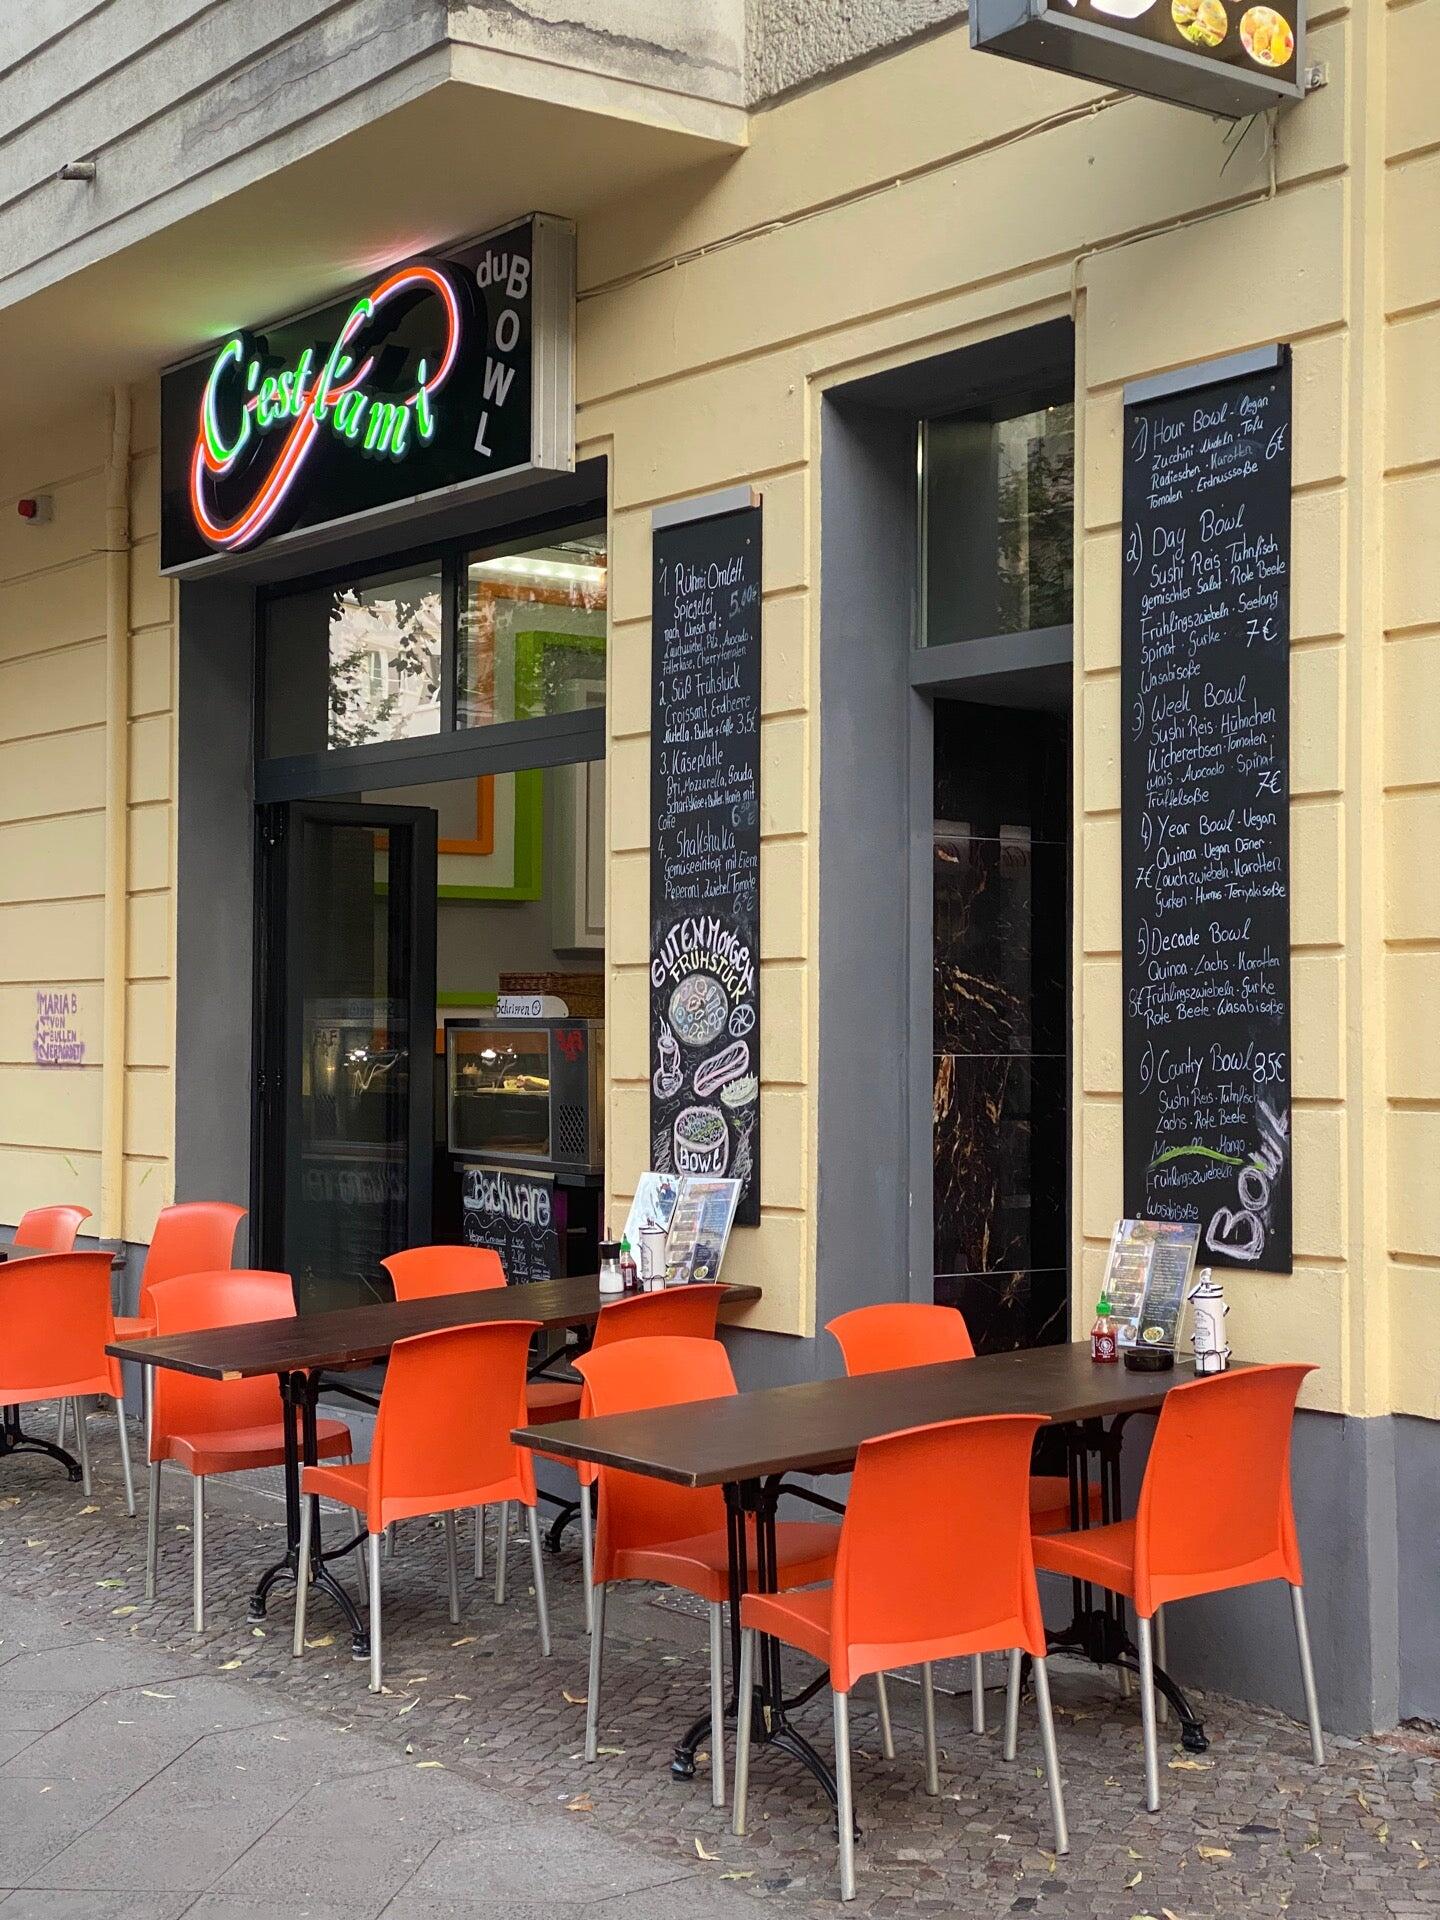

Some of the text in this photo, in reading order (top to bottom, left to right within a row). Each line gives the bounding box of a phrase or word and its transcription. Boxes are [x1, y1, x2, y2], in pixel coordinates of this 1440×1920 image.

[1153, 417, 1186, 450] Hour
[1193, 402, 1228, 432] Bowl
[1151, 444, 1195, 471] Zucchini
[1240, 415, 1264, 435] Tofu
[1151, 464, 1201, 491] Radieschen
[1146, 486, 1183, 510] Tomaten
[1152, 526, 1187, 561] Day
[1199, 503, 1246, 543] Bowl
[1150, 555, 1186, 589] Sushi
[1190, 548, 1221, 578] Reis
[1196, 568, 1223, 595] Salat
[1231, 566, 1255, 586] Rote
[1256, 555, 1288, 579] Beete
[1140, 634, 1176, 672] Spinat
[1203, 675, 1247, 708] Bowl
[1150, 716, 1185, 746] Sushi
[1187, 714, 1214, 737] Reis
[1148, 729, 1267, 774] Kichererbsen Tomaten
[1236, 744, 1276, 776] Spinat
[1157, 815, 1190, 845] Year
[1199, 809, 1236, 835] Bowl
[1243, 808, 1277, 830] Vegan
[1204, 843, 1231, 861] Vegan
[1234, 852, 1281, 877] Karotten
[1151, 927, 1201, 956] Decade
[1209, 917, 1252, 944] Bowl
[1148, 945, 1281, 981] Quinoa Lachs Karotten
[1241, 971, 1276, 999] Gurke
[1143, 1004, 1172, 1030] Rote
[1176, 999, 1212, 1020] Beete
[1210, 1041, 1254, 1072] Bowl
[1158, 1084, 1190, 1114] Sushi
[1194, 1109, 1217, 1130] Rote
[1218, 1107, 1248, 1127] Beete
[463, 1169, 551, 1228] Backware
